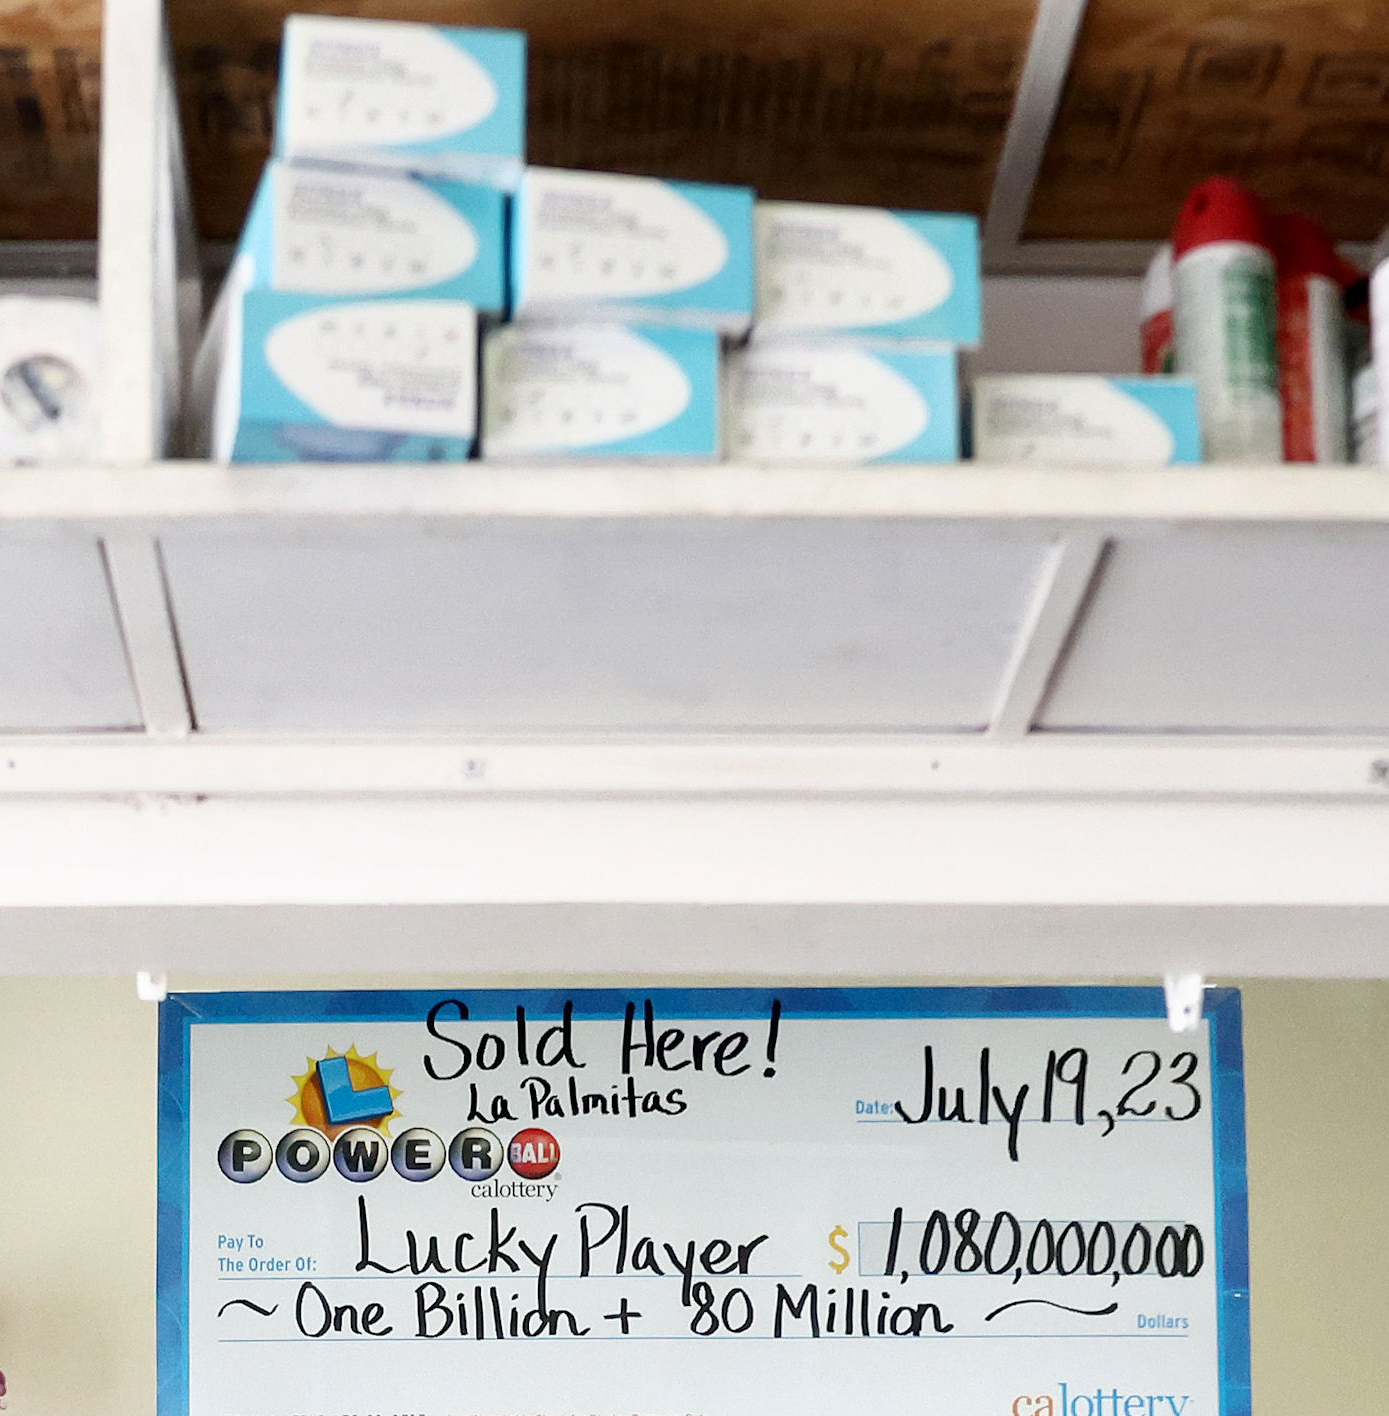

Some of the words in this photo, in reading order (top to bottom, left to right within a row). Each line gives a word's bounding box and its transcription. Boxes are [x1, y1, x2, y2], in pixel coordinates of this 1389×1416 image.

[424, 1000, 586, 1080] Sold
[621, 999, 781, 1077] Here!
[467, 1084, 517, 1123] La
[520, 1076, 688, 1120] Palmitas
[856, 1099, 895, 1116] Date:
[893, 1046, 1029, 1161] July
[471, 1179, 559, 1201] calottery
[218, 1234, 244, 1251] Pay
[247, 1234, 264, 1249] To
[218, 1256, 243, 1272] The
[247, 1256, 292, 1272] Order
[296, 1256, 318, 1273] Of:
[355, 1195, 558, 1318] Lucky
[574, 1202, 769, 1307] Player
[828, 1225, 851, 1275] $
[884, 1207, 1204, 1287] 1,080,000,000
[296, 1281, 394, 1338] One
[414, 1281, 591, 1340] Billion
[604, 1297, 642, 1335] +
[689, 1286, 754, 1337] 80
[774, 1283, 954, 1338] Million
[1137, 1314, 1190, 1330] Dollars
